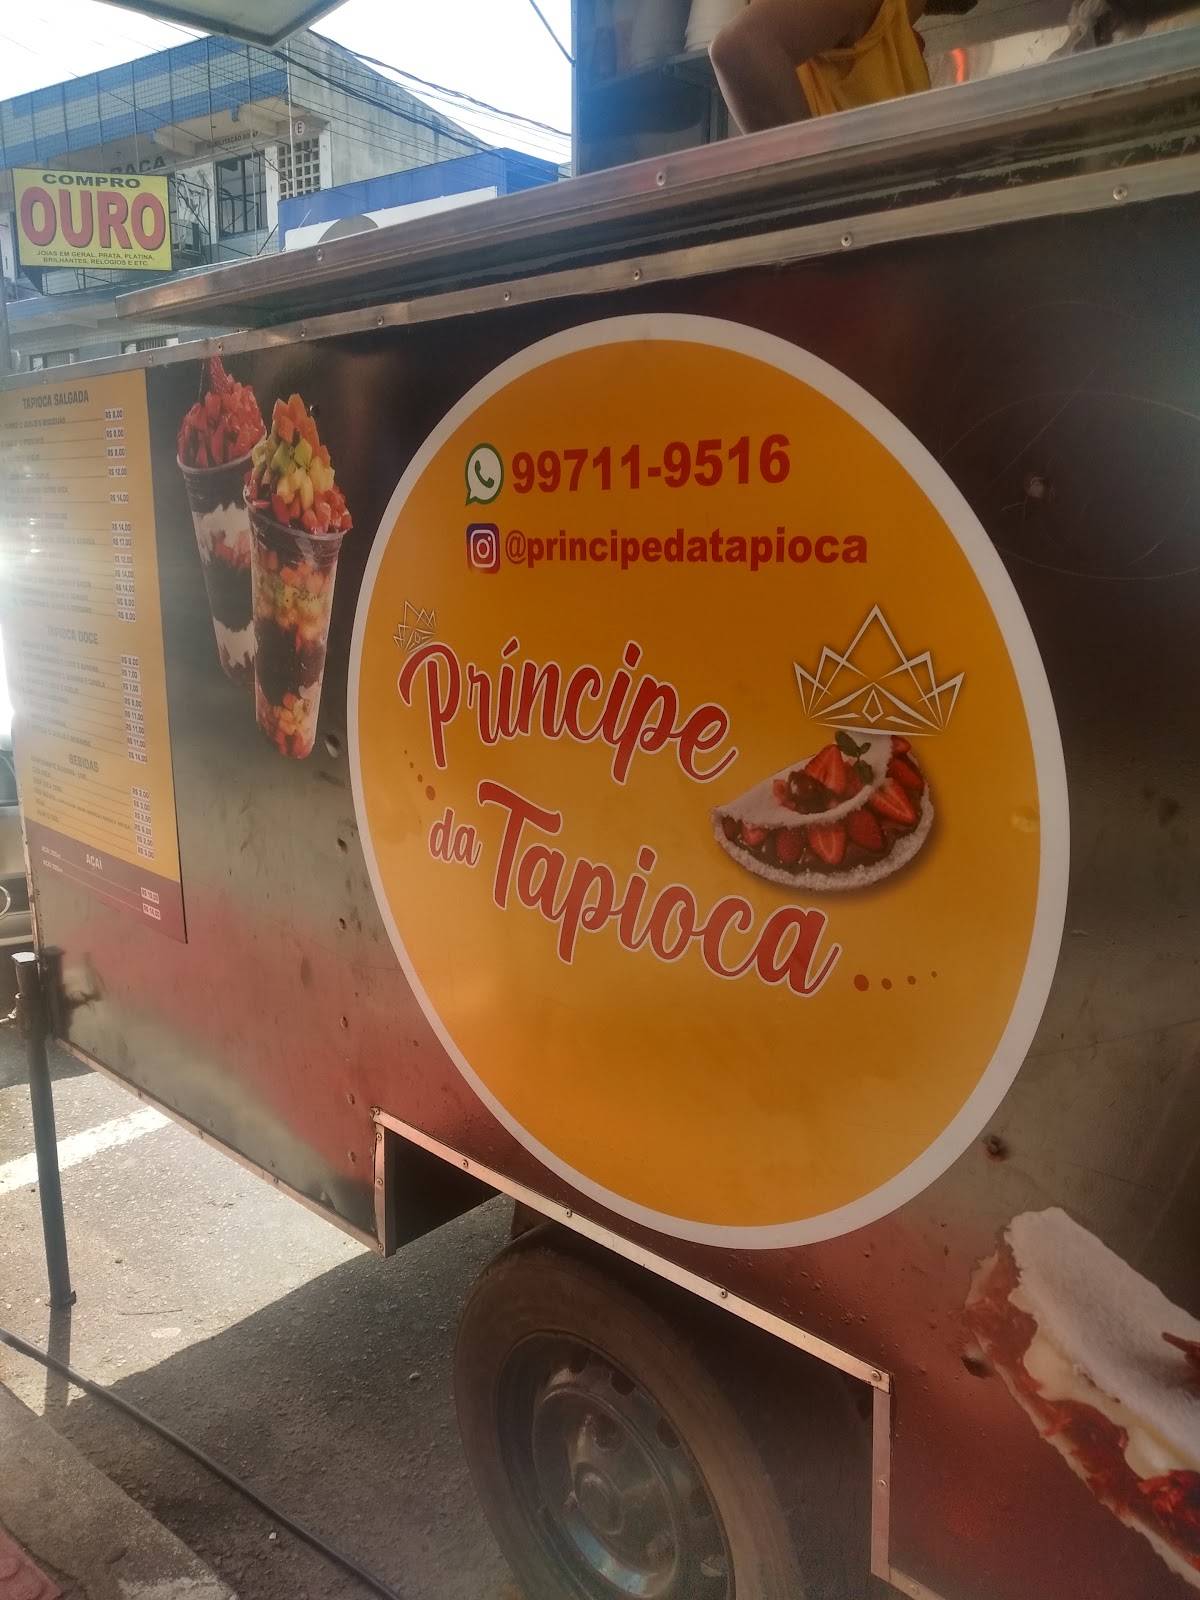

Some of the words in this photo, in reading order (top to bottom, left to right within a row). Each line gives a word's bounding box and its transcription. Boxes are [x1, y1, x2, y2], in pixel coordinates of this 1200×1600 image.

[42, 173, 141, 189] COMPRO
[20, 186, 166, 251] OURO
[22, 394, 52, 409] TAPIOCA
[53, 389, 89, 406] SALGADA
[511, 433, 791, 495] 99711-9516
[505, 526, 869, 572] @principedatapioca
[398, 636, 739, 786] Príncipe
[428, 807, 483, 869] da
[477, 778, 843, 997] Tapioca
